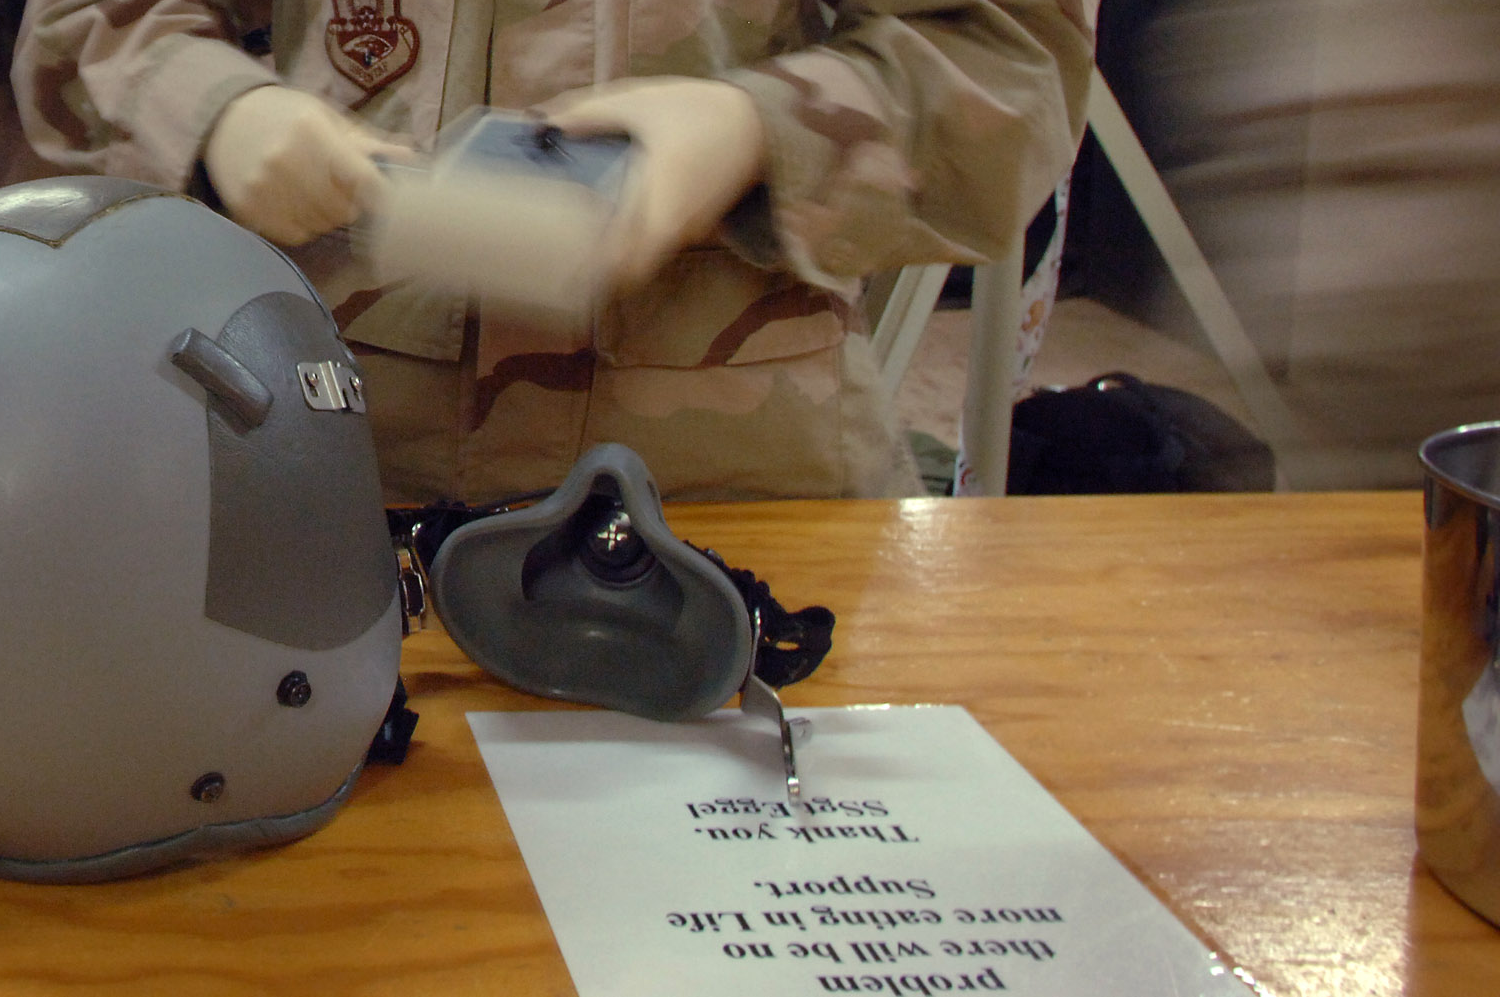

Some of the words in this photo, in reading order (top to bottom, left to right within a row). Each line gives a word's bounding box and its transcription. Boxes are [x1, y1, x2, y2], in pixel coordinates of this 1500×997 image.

[686, 797, 792, 819] Eggel
[802, 797, 889, 817] SSgt
[694, 822, 778, 841] you.
[786, 824, 920, 844] Thank
[754, 875, 936, 899] Support.
[666, 911, 754, 933] Life
[762, 911, 808, 931] in
[811, 905, 942, 930] eating
[953, 907, 1066, 924] more
[723, 942, 776, 959] no
[787, 942, 843, 964] be
[848, 941, 932, 963] will
[940, 939, 1056, 961] there
[816, 967, 1007, 997] problem
